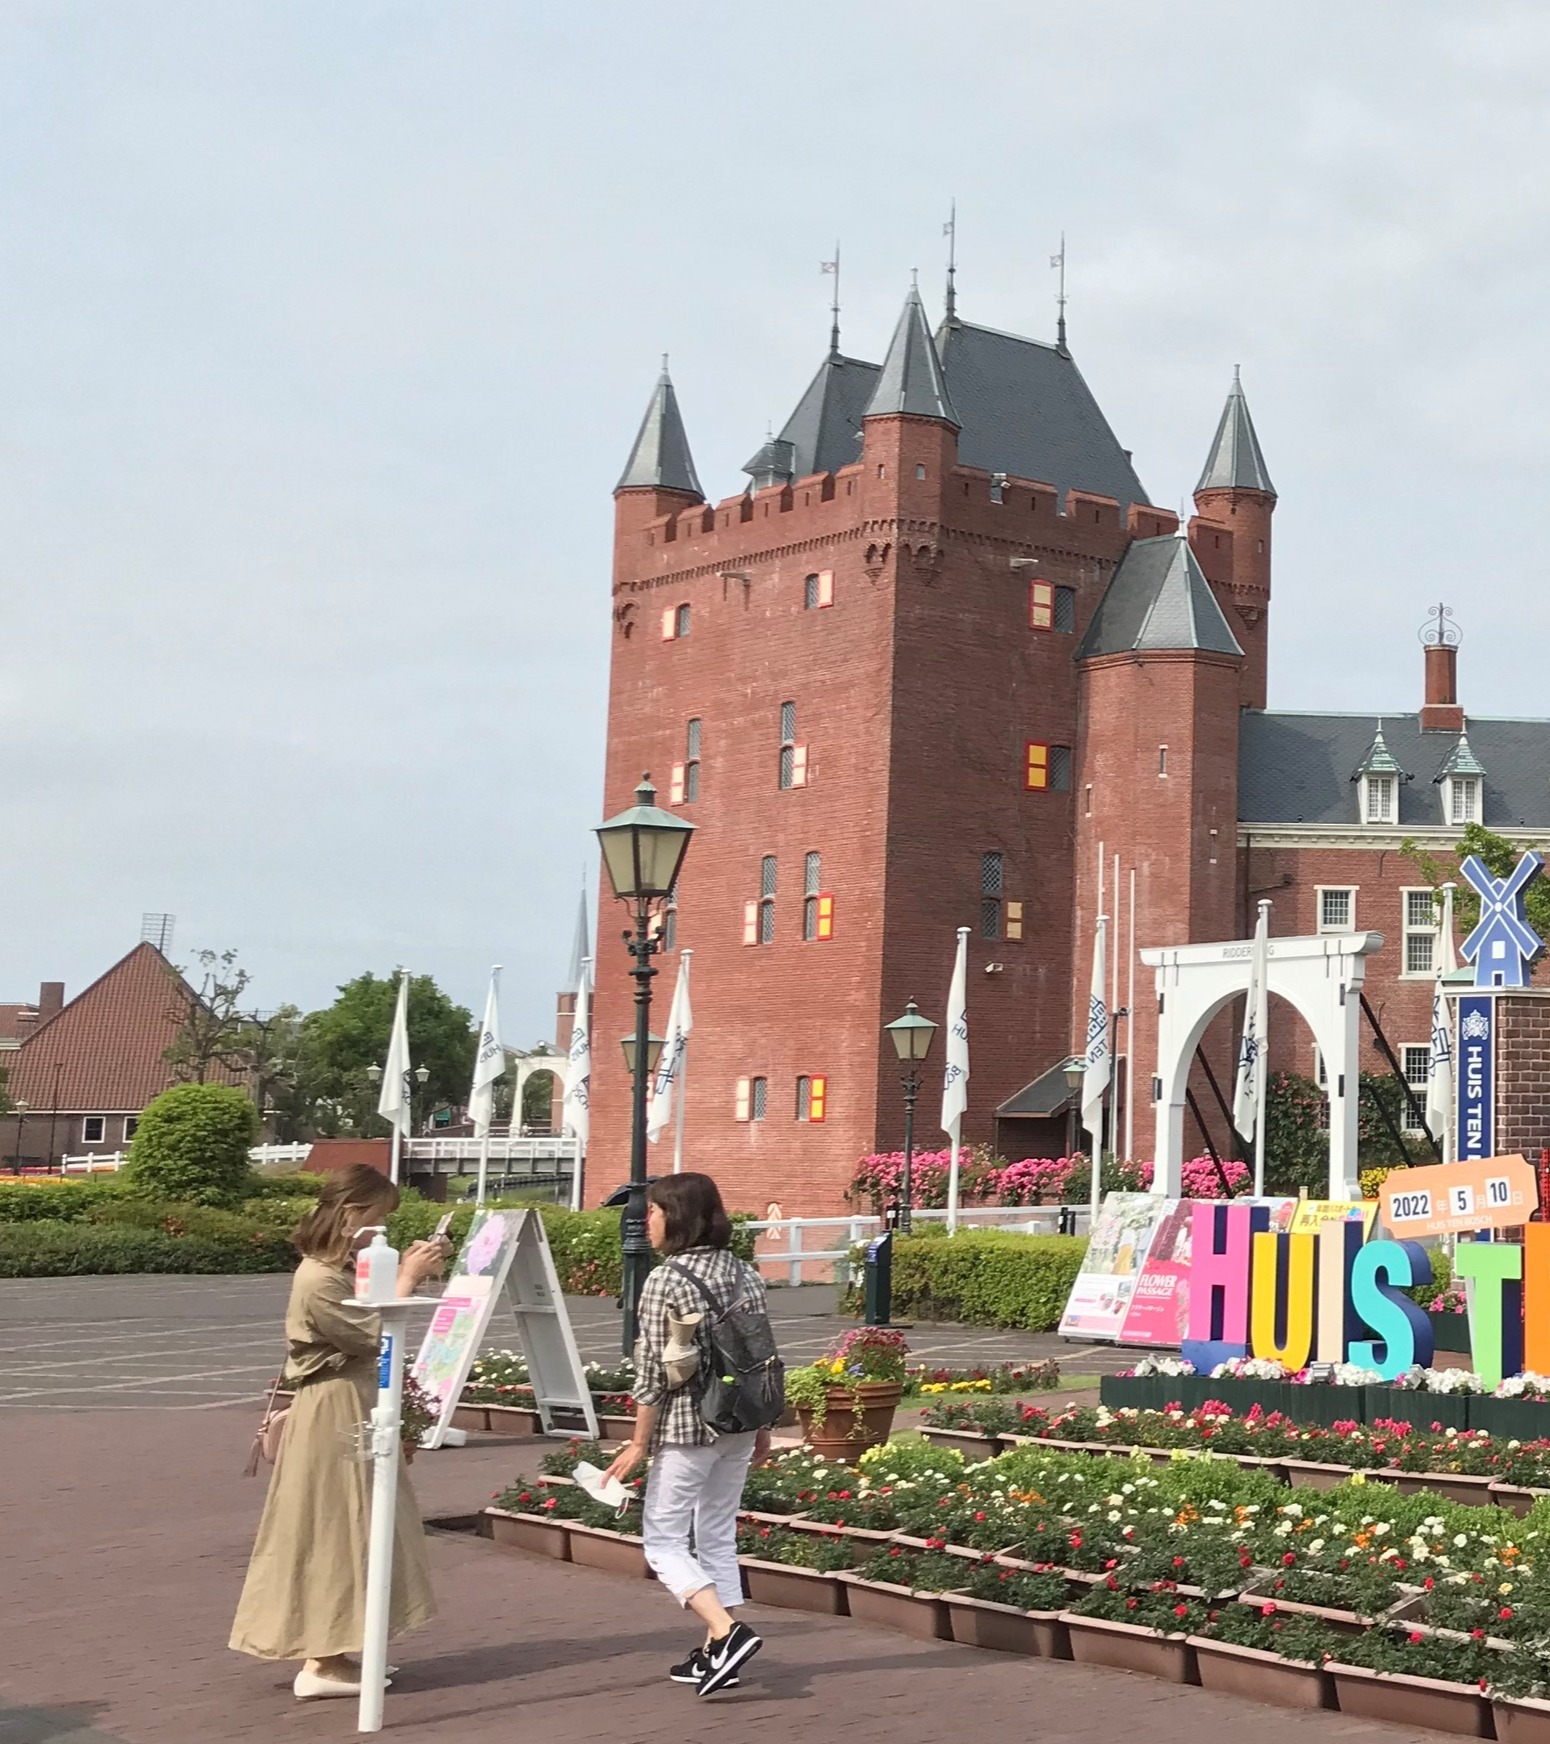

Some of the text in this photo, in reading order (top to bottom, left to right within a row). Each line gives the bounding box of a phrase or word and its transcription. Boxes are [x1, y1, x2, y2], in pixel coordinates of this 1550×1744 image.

[1222, 944, 1275, 958] RIDDERG
[1467, 1046, 1482, 1099] HUIS
[1467, 1103, 1482, 1148] TEN
[1393, 1181, 1523, 1218] 2022 年 5 月 10 日
[1426, 1214, 1493, 1230] HUIS TEN BOSCH
[1137, 1286, 1174, 1296] PASSAGE
[1140, 1274, 1177, 1287] FLOWER
[1191, 1205, 1414, 1382] HUIS
